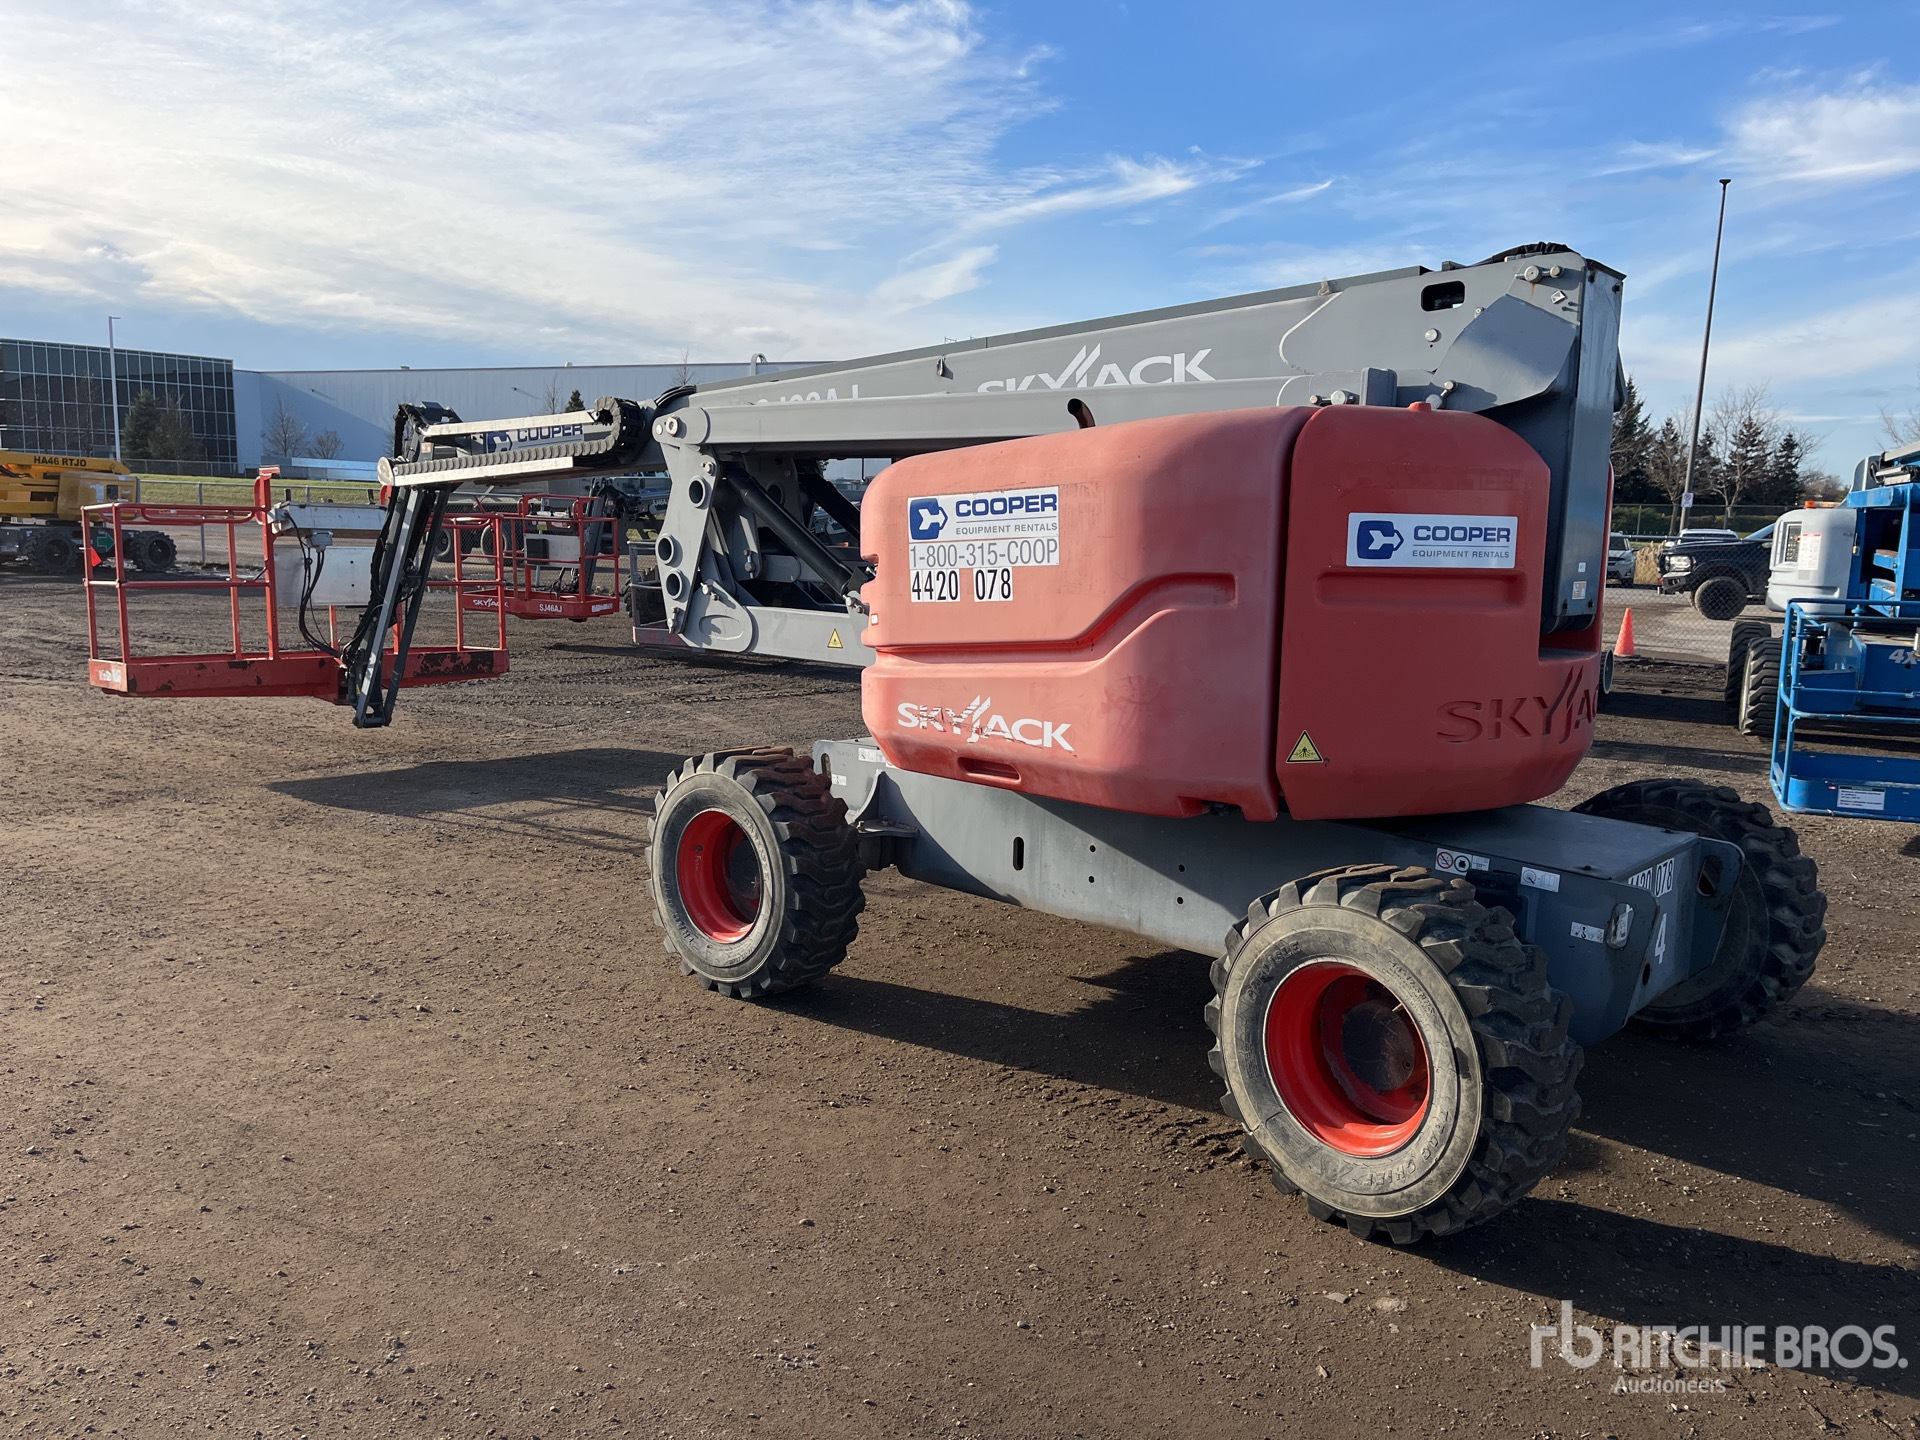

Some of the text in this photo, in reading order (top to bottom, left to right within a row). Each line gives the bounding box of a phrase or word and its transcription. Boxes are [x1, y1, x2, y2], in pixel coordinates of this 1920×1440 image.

[33, 456, 60, 466] HA46
[955, 493, 1058, 517] COOPER
[956, 522, 1058, 535] EQUIPMENT RENTALS
[1413, 525, 1511, 543] COOPER
[910, 538, 1058, 568] 1-800-315-COOP
[1412, 550, 1510, 559] EQUIPMENT RENTALS
[912, 568, 1011, 601] 4420 078
[539, 603, 563, 613] SJ46AJ
[897, 695, 1076, 752] SKYJACK
[1655, 859, 1674, 897] 078
[1655, 912, 1668, 965] 4
